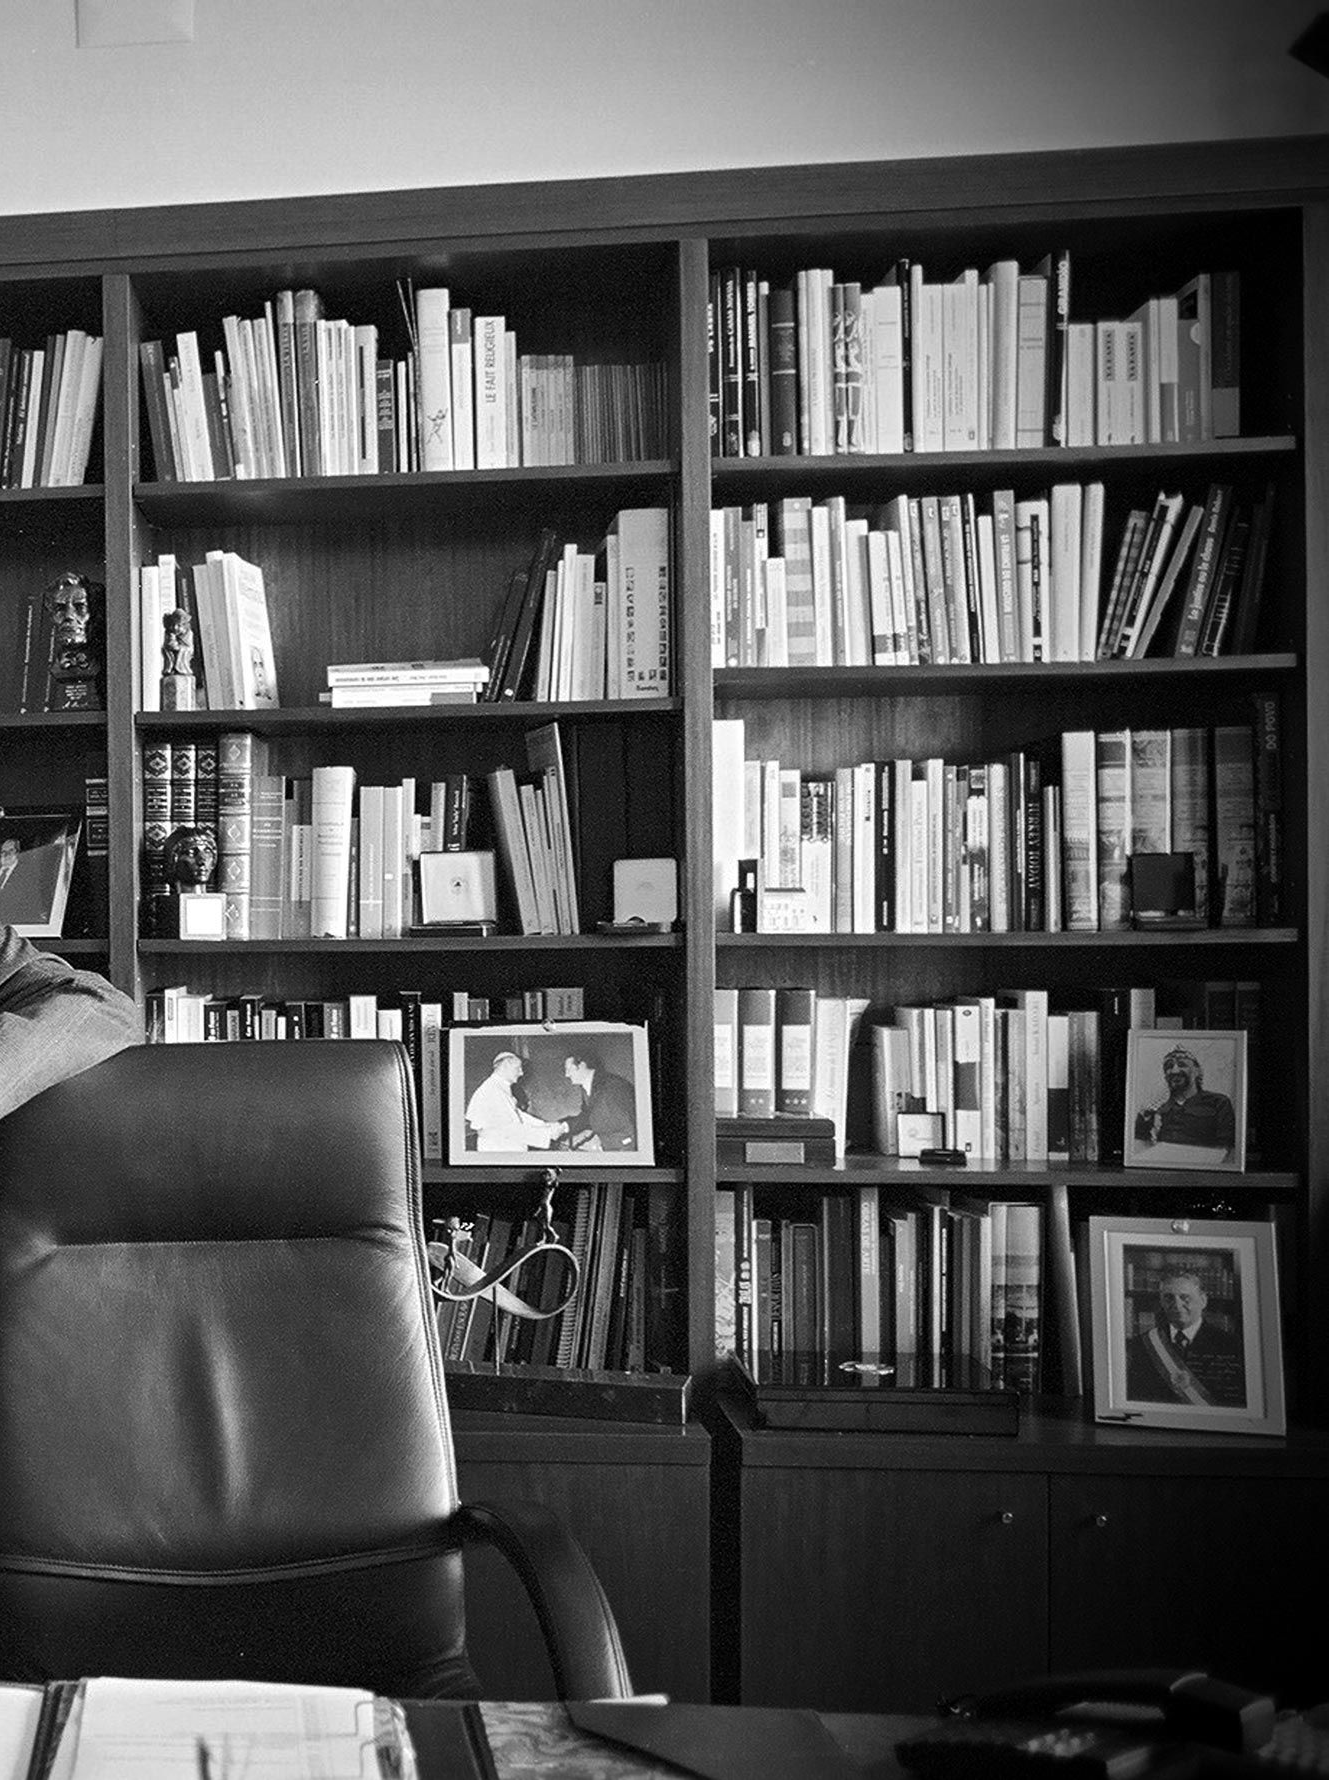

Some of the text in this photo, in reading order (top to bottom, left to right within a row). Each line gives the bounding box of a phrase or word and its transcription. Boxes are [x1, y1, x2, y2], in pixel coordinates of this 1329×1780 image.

[484, 320, 497, 405] LE FAIT RELIGIEUX
[1264, 702, 1278, 733] POVO
[1027, 802, 1039, 889] TURKEY TODAY
